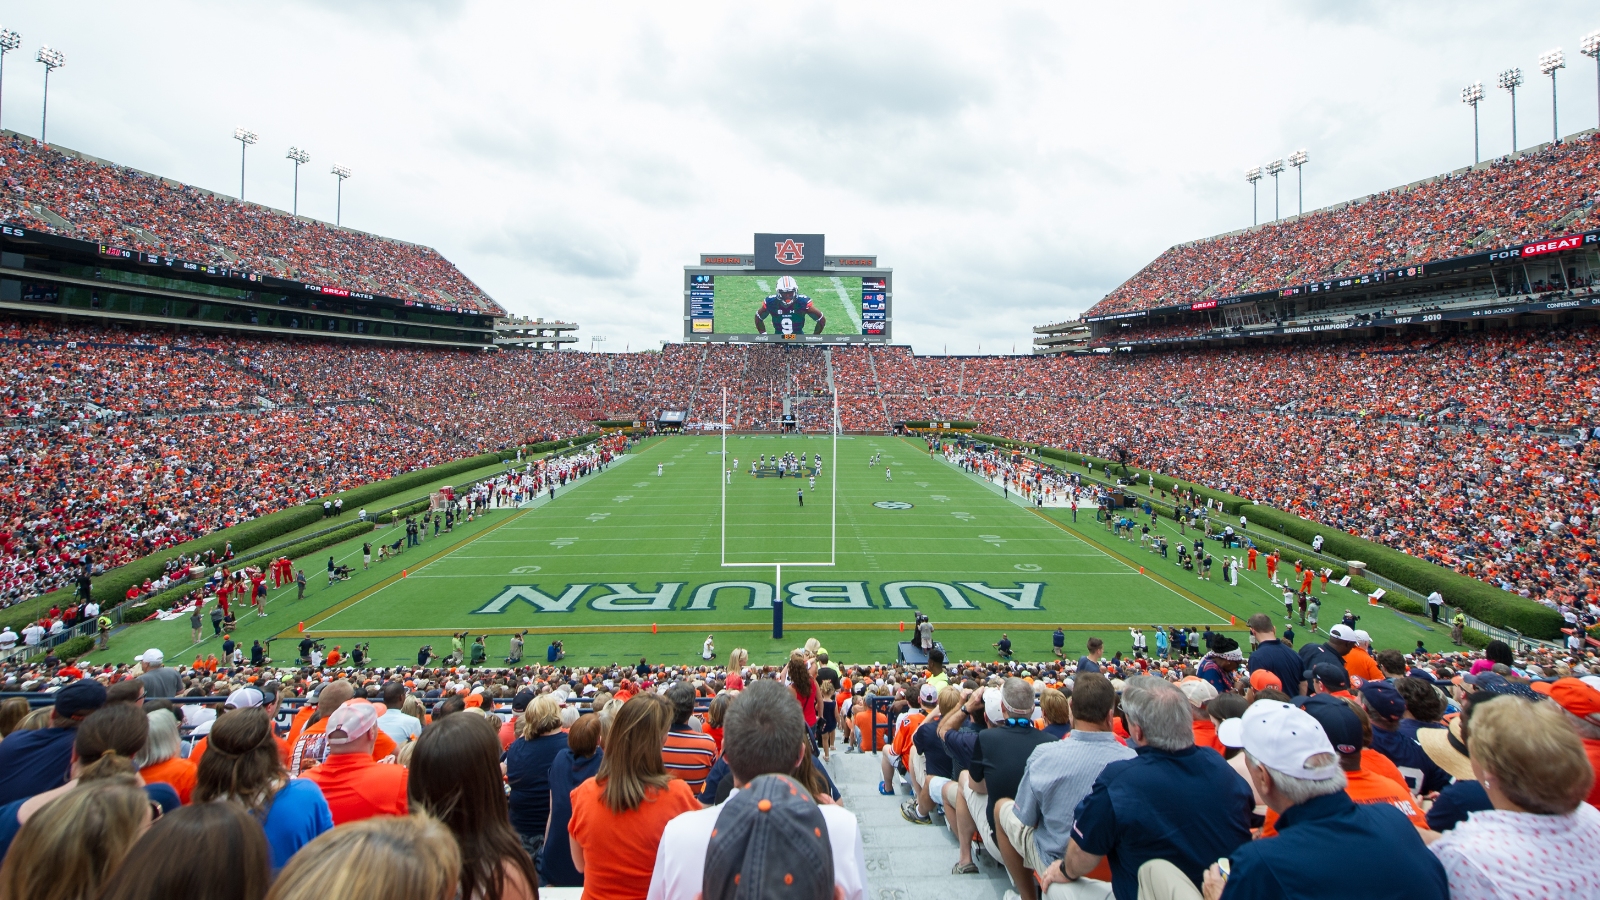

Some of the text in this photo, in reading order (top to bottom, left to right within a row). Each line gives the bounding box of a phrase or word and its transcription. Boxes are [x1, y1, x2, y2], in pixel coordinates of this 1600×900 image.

[0, 226, 24, 237] ES
[1489, 234, 1600, 260] FOR GREAT R
[704, 257, 741, 265] AUBURN
[838, 258, 873, 266] TIGERS
[305, 284, 374, 300] FOR GREAT RATES
[1192, 301, 1216, 309] GREAT
[1217, 298, 1241, 306] RATES
[1546, 300, 1580, 309] CONFERENCE
[1395, 313, 1442, 324] 1957 2010
[781, 318, 793, 335] 9
[1283, 326, 1310, 334] NATIONAL
[1313, 323, 1349, 331] CHAMPIONS
[470, 580, 1048, 614] AUBURN
